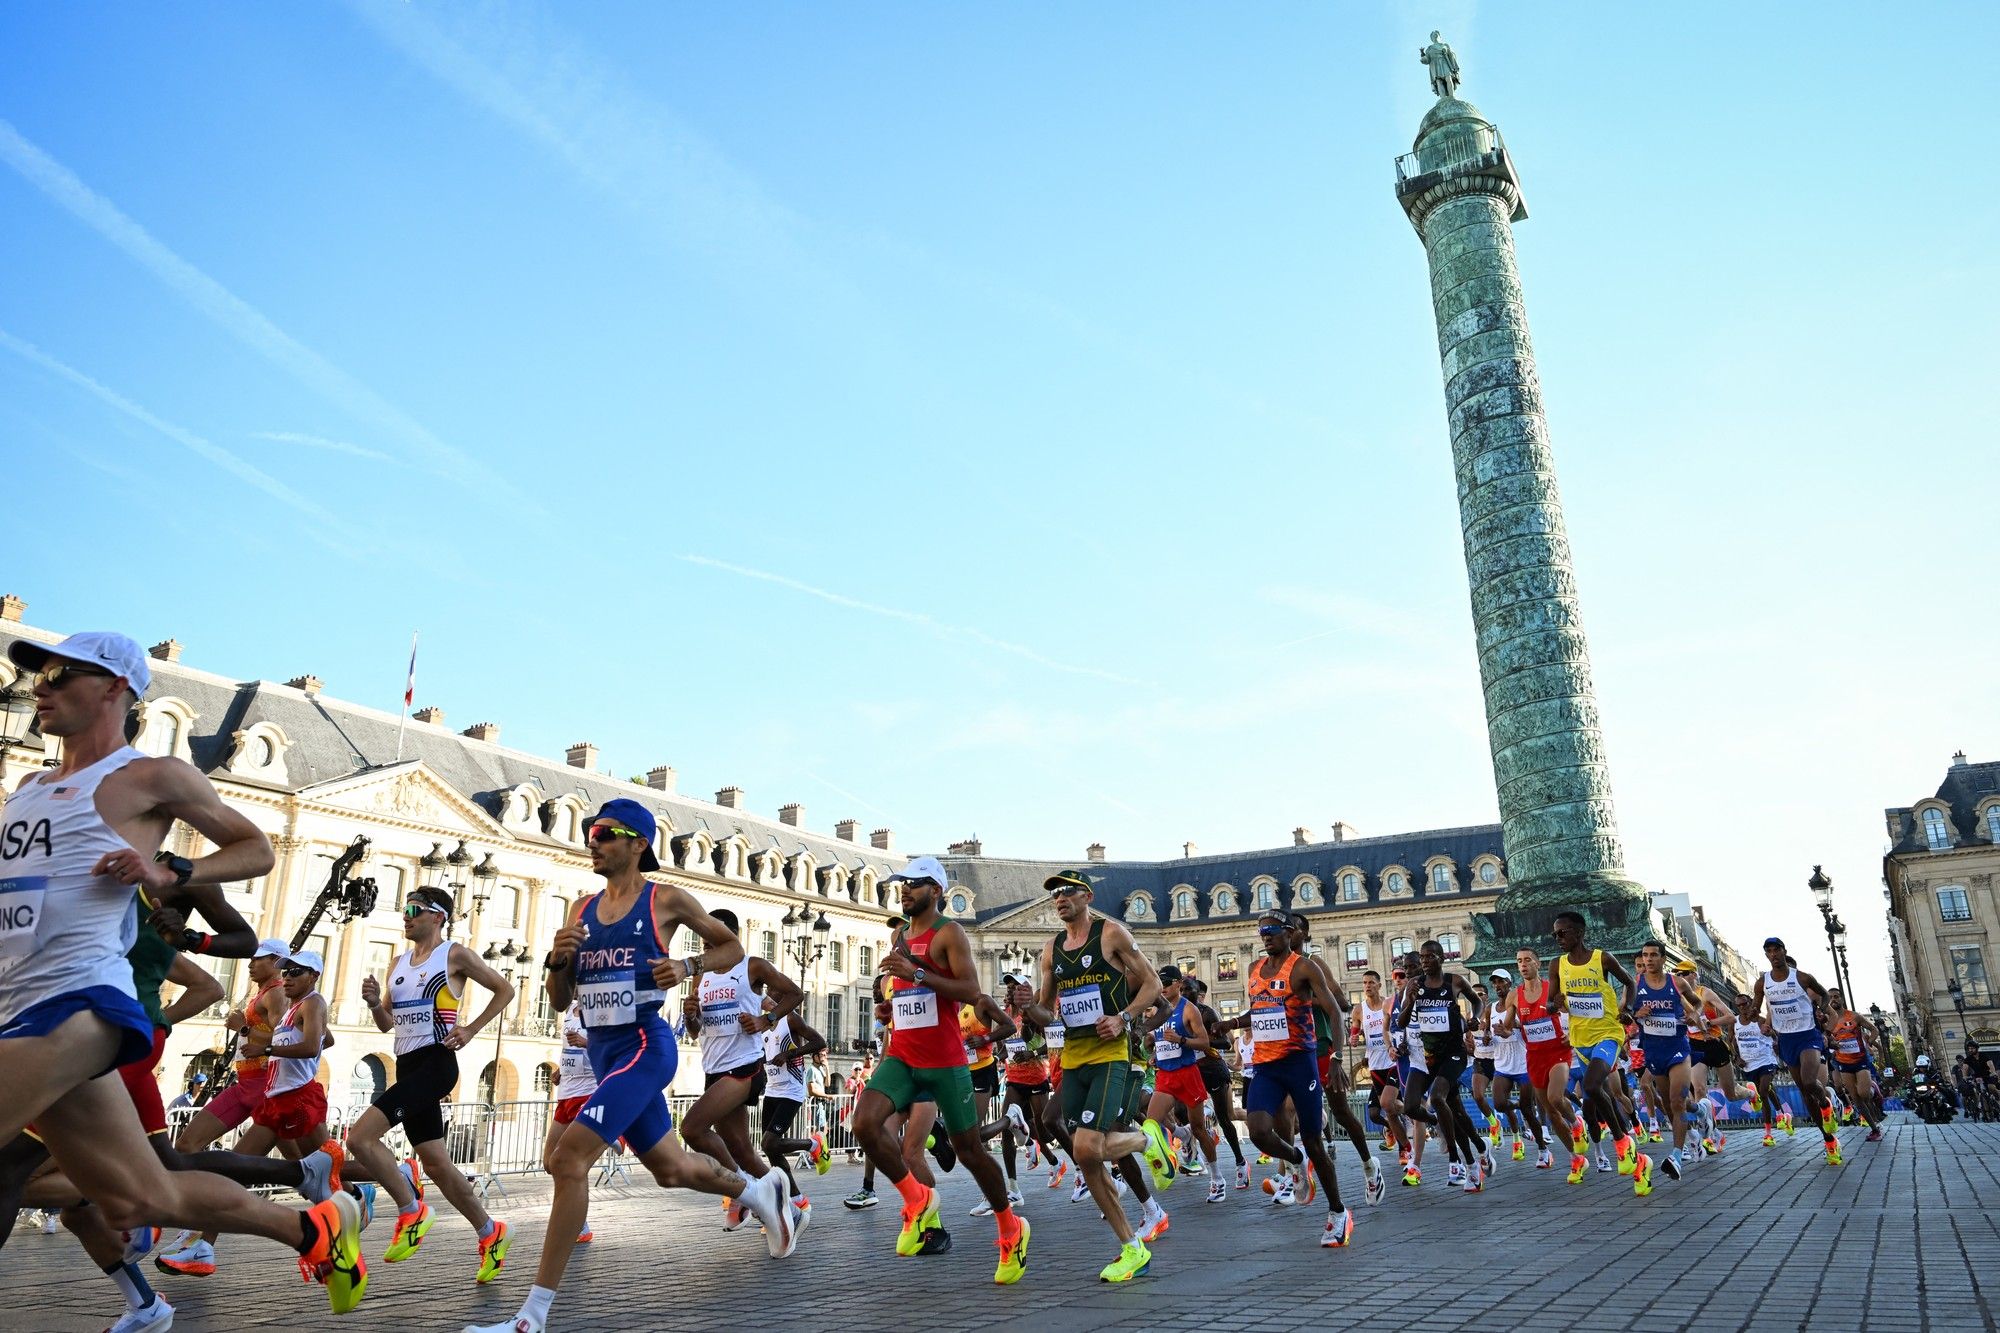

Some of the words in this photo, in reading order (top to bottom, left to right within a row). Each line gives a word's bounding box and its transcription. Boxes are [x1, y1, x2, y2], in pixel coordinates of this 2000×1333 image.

[0, 905, 34, 931] NG
[579, 948, 636, 971] FRANCE
[1075, 973, 1111, 987] AFRICA
[1566, 978, 1599, 989] SWEDEN
[579, 990, 634, 1010] AVARRO
[1062, 998, 1100, 1015] GELANT
[1569, 1000, 1603, 1011] HASSAN
[1642, 1000, 1673, 1010] FRANCE
[898, 1001, 926, 1017] TALBI
[1774, 1005, 1797, 1015] FREIRE
[1252, 1018, 1287, 1032] AGEEYE
[1644, 1019, 1675, 1029] CHAHDI
